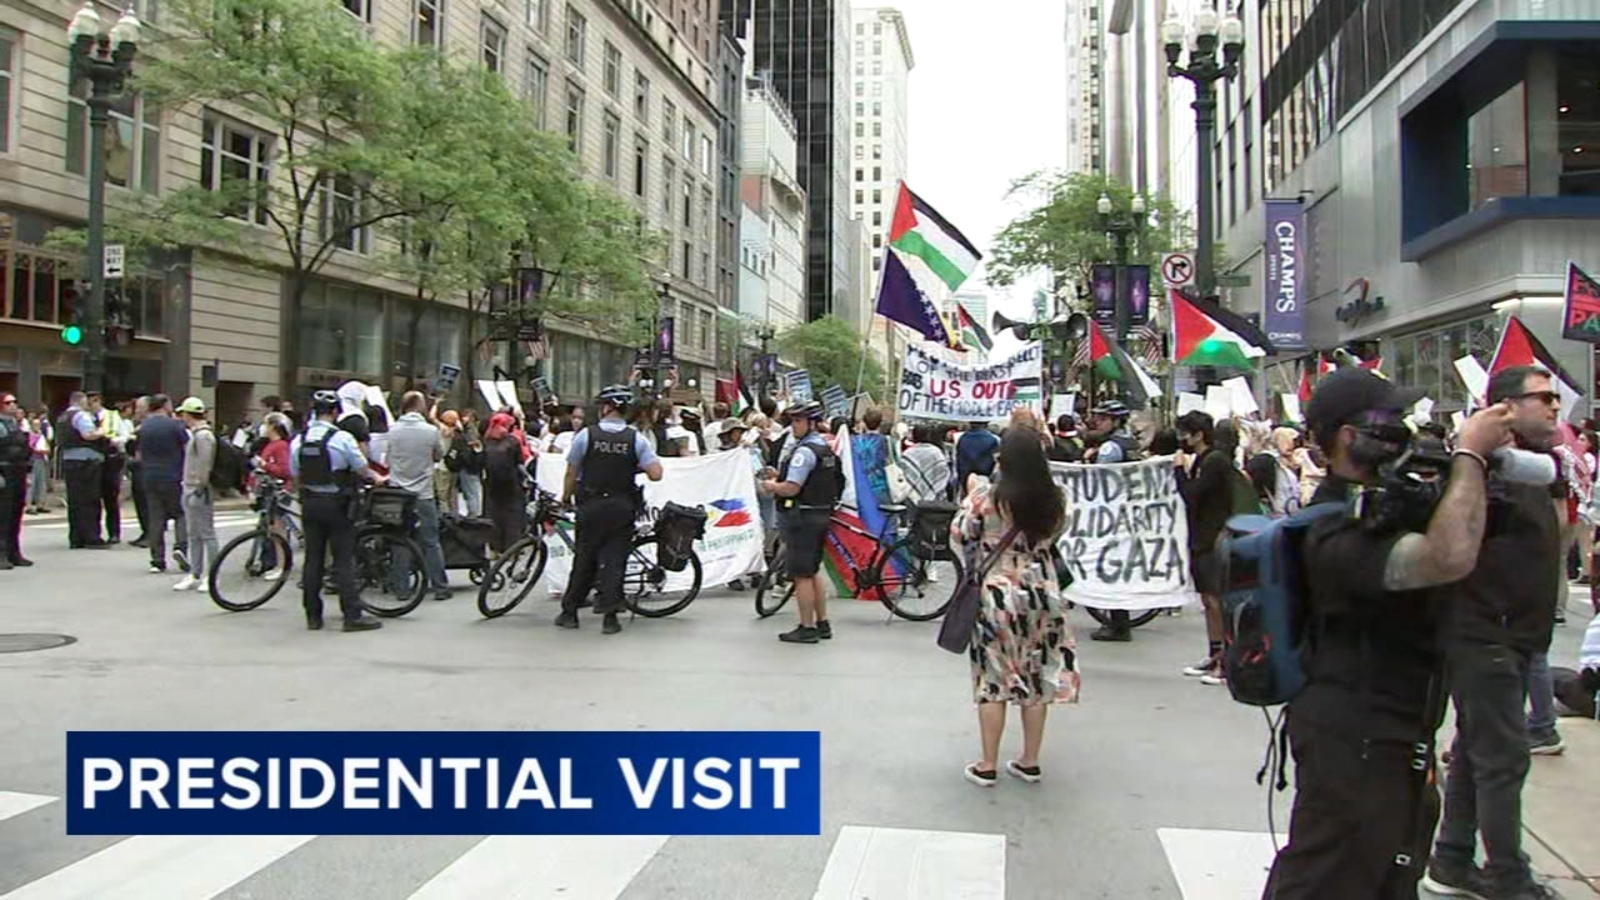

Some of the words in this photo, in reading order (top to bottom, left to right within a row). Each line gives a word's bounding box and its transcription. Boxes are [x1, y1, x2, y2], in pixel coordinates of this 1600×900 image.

[1274, 221, 1296, 313] CHAMPS
[594, 440, 629, 455] POLICE
[1069, 500, 1177, 538] LIDARITY
[1096, 537, 1186, 586] GAZA
